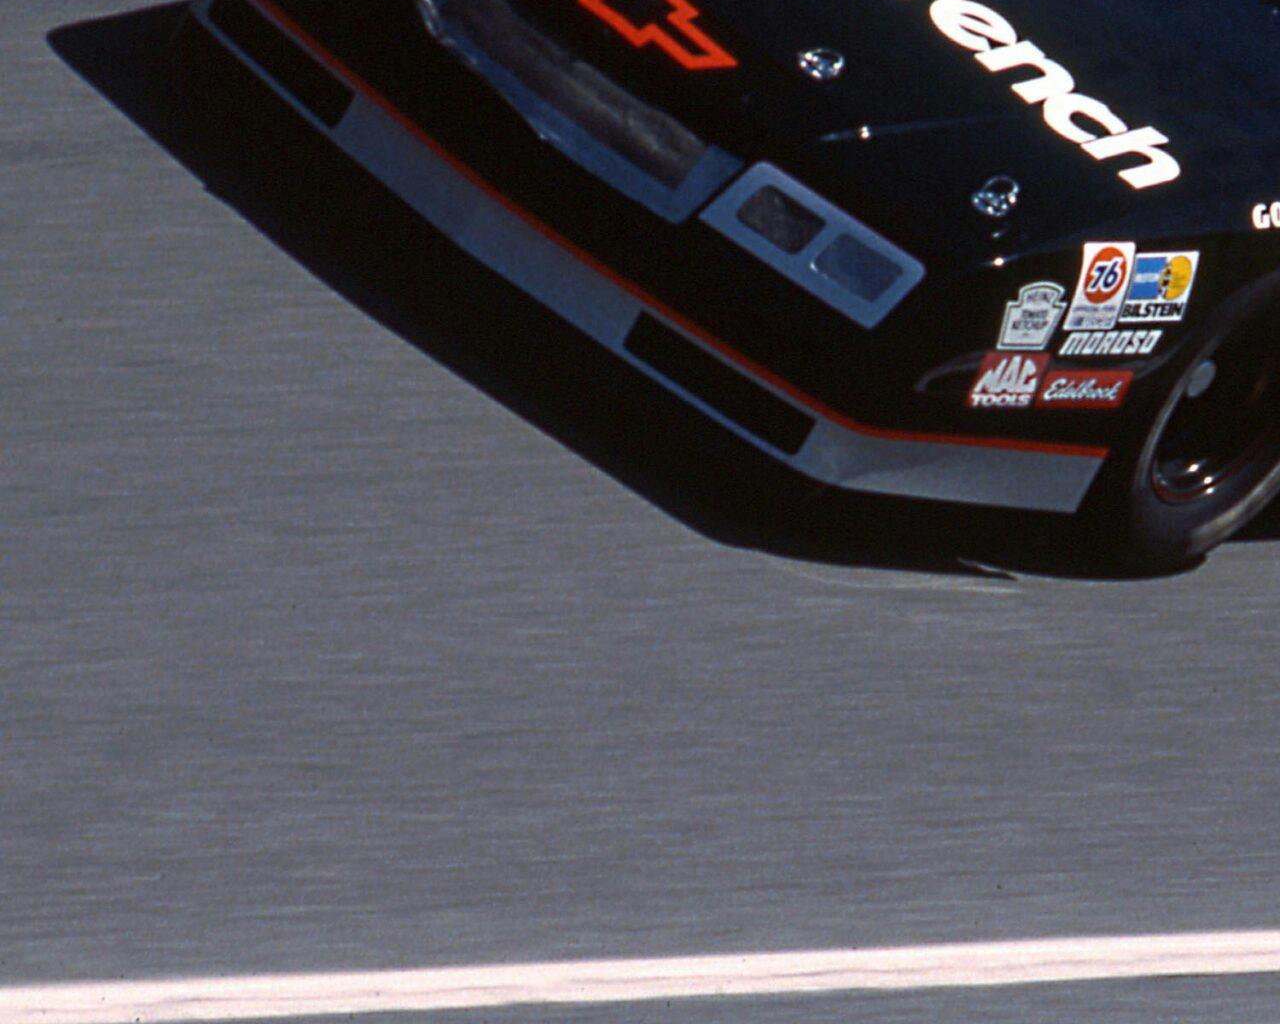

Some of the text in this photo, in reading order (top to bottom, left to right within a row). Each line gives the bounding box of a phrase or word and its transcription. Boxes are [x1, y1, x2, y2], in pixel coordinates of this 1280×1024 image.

[1088, 258, 1122, 291] 76
[1120, 302, 1185, 319] BILSTEIN
[1059, 330, 1163, 355] MOROSO
[973, 354, 1037, 393] MAC
[971, 393, 1032, 407] TOOLS
